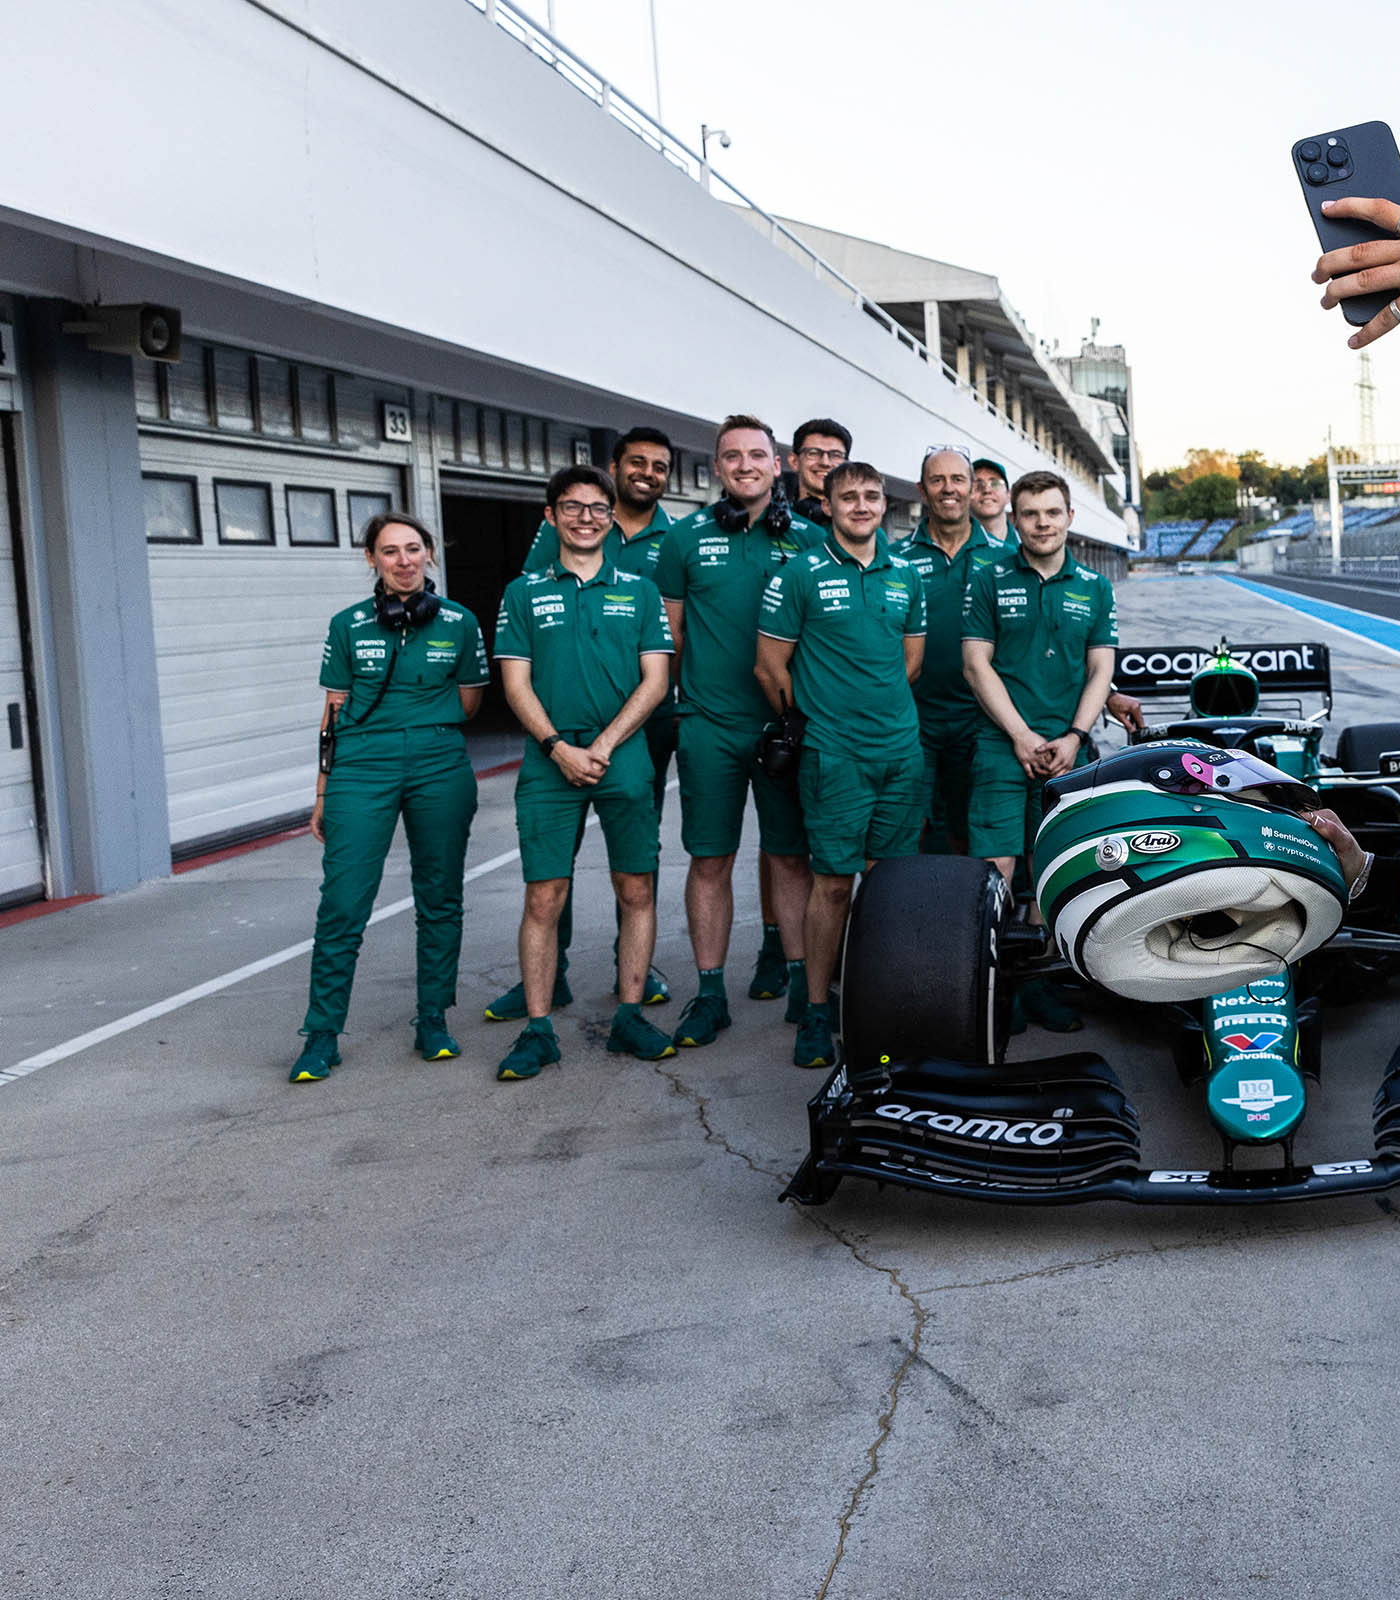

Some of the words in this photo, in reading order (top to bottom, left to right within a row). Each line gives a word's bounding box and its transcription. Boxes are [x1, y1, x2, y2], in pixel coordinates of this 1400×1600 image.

[389, 411, 407, 435] 33
[1120, 645, 1315, 684] cogzant
[1146, 740, 1221, 751] aram
[1136, 834, 1173, 846] Arai
[1273, 830, 1319, 851] SentinelOne
[1277, 844, 1321, 864] crypto.com
[1212, 995, 1287, 1010] NetApp
[1214, 1012, 1288, 1031] PIRELLI
[875, 1104, 1063, 1146] aramco
